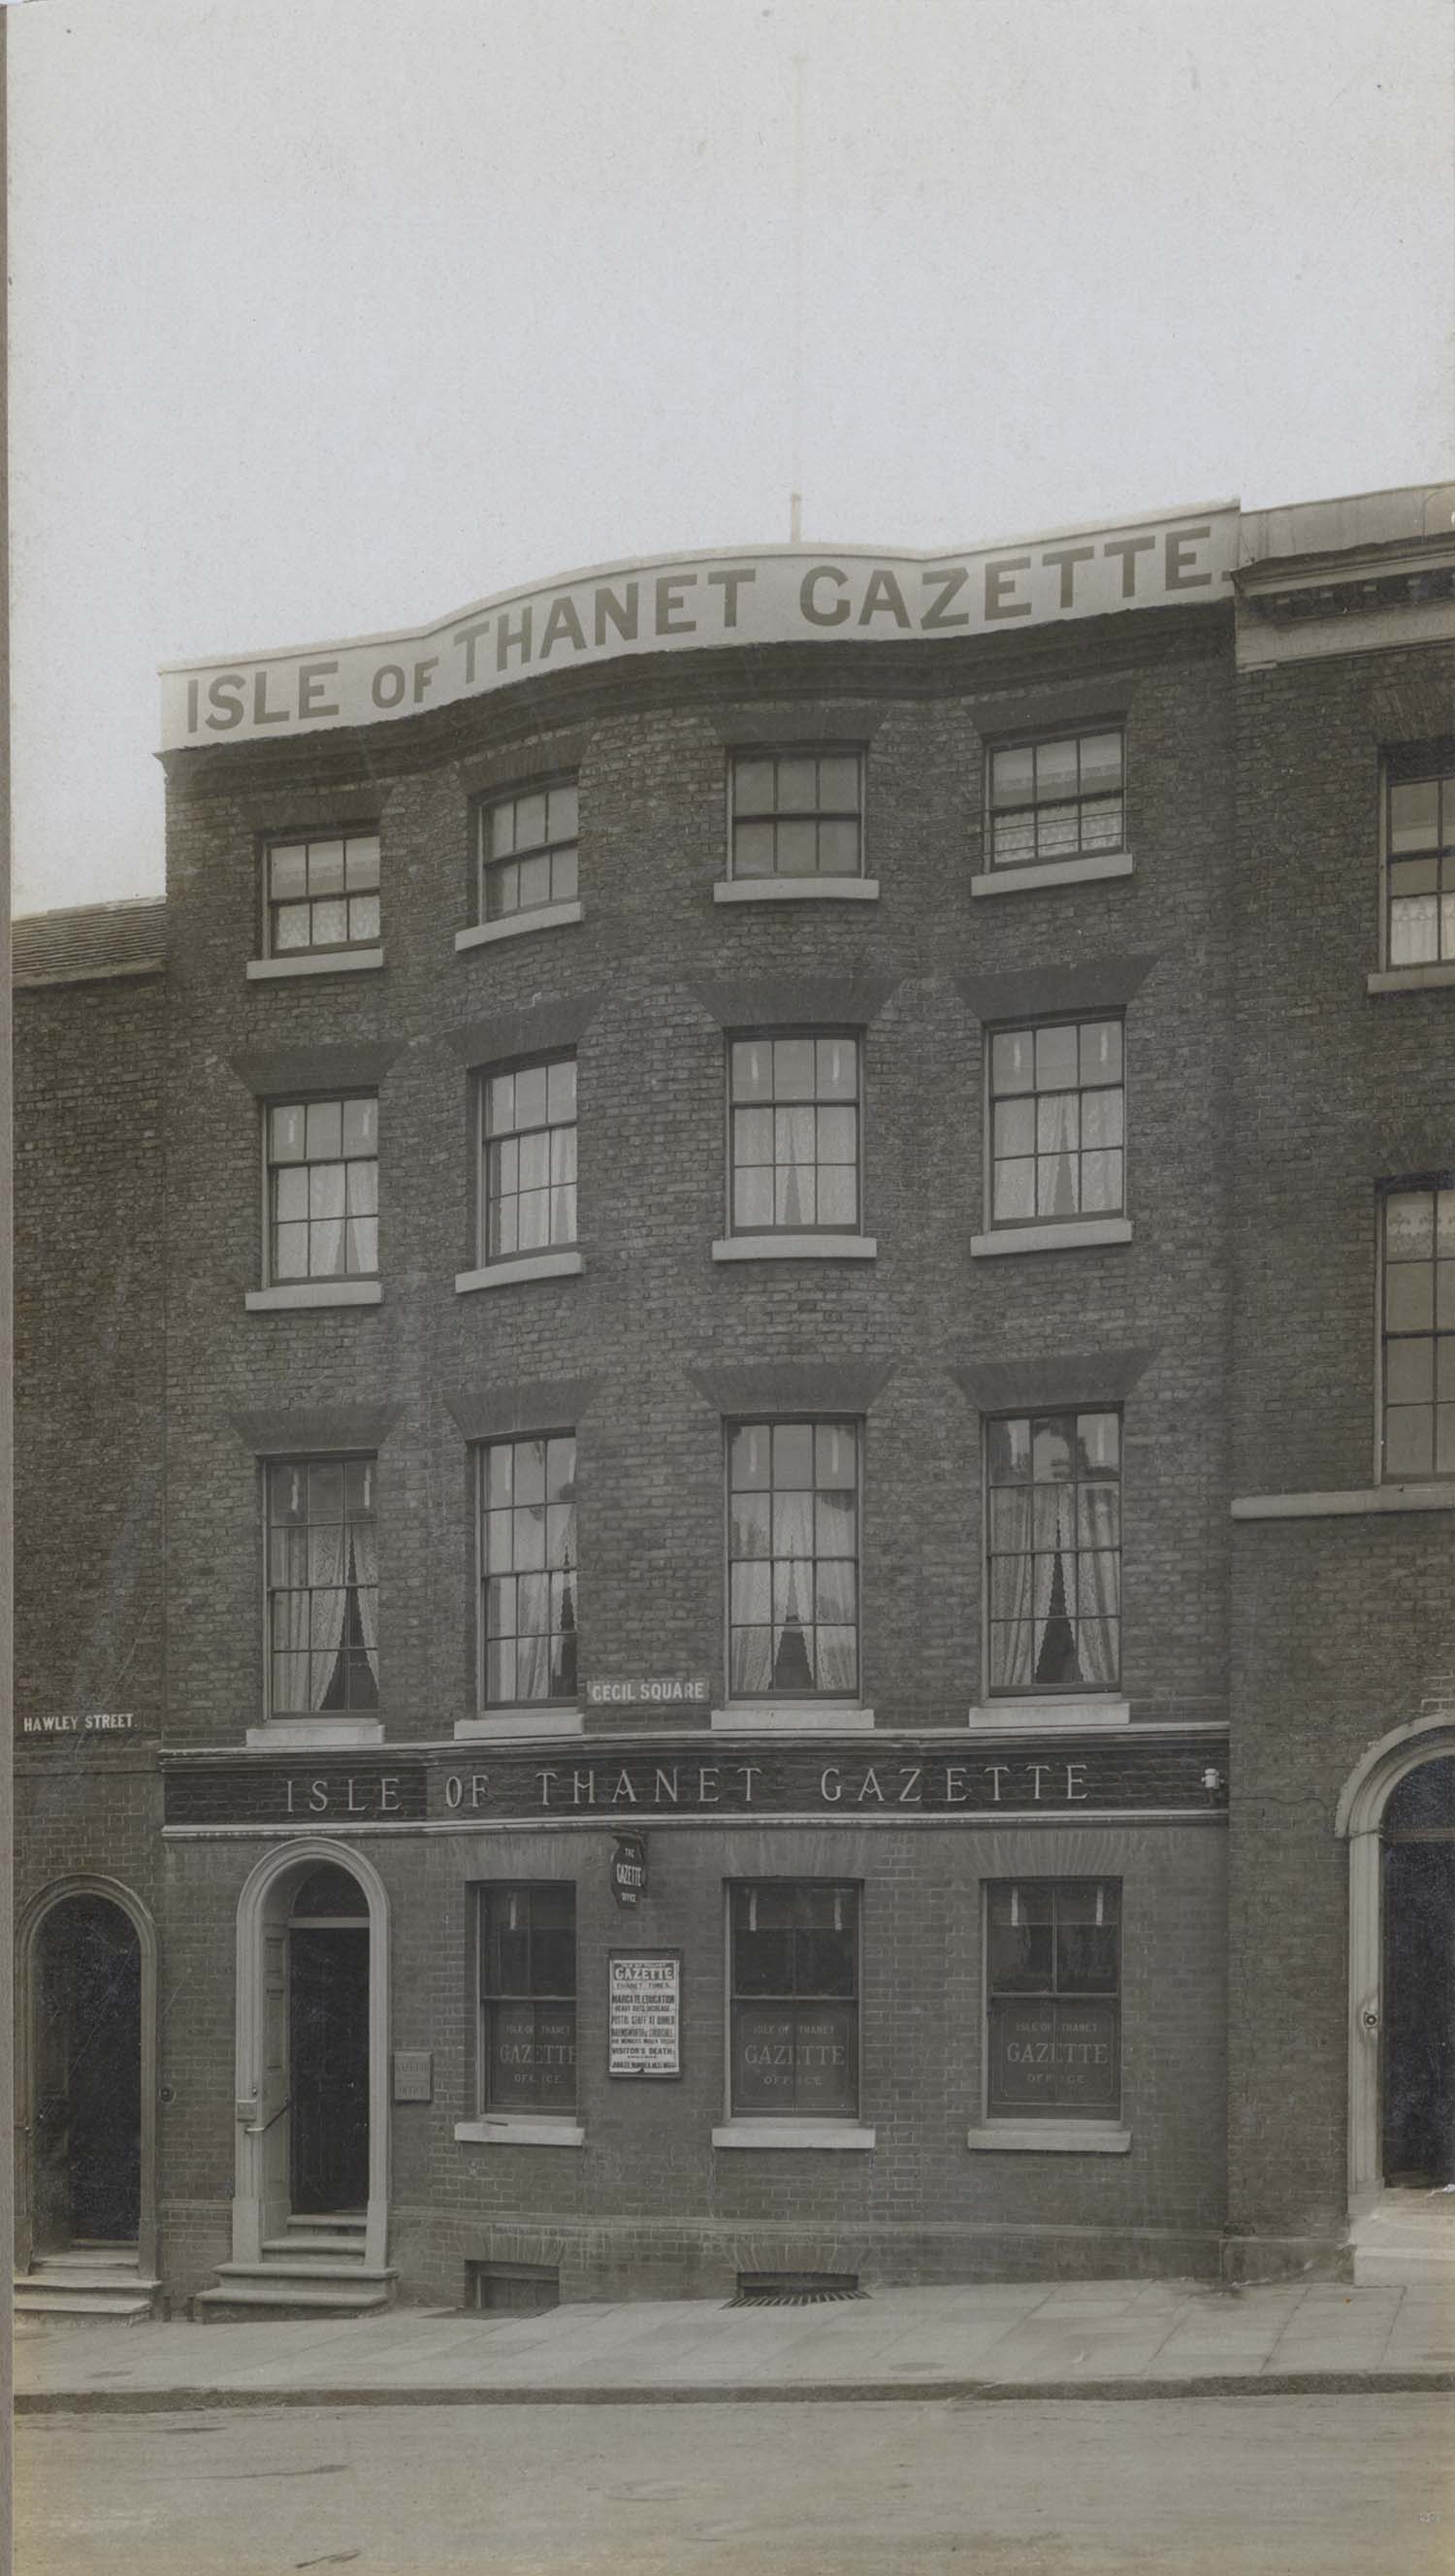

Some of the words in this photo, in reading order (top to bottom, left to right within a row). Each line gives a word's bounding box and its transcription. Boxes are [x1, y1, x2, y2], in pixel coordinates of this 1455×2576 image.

[187, 661, 340, 733] ISLE
[371, 656, 439, 708] OF
[454, 568, 757, 684] THANET
[593, 1683, 636, 1701] CECIL
[639, 1681, 705, 1700] SQUARE
[23, 1716, 78, 1731] HAWLEY
[287, 1778, 402, 1811] ISLE
[445, 1775, 489, 1809] OF
[535, 1767, 762, 1807] THANET
[821, 1764, 1087, 1802] GAZETTE
[615, 1968, 673, 1980] GAZETTE
[744, 2043, 846, 2066] GAZETTE
[1007, 2042, 1110, 2065] GAZETTE
